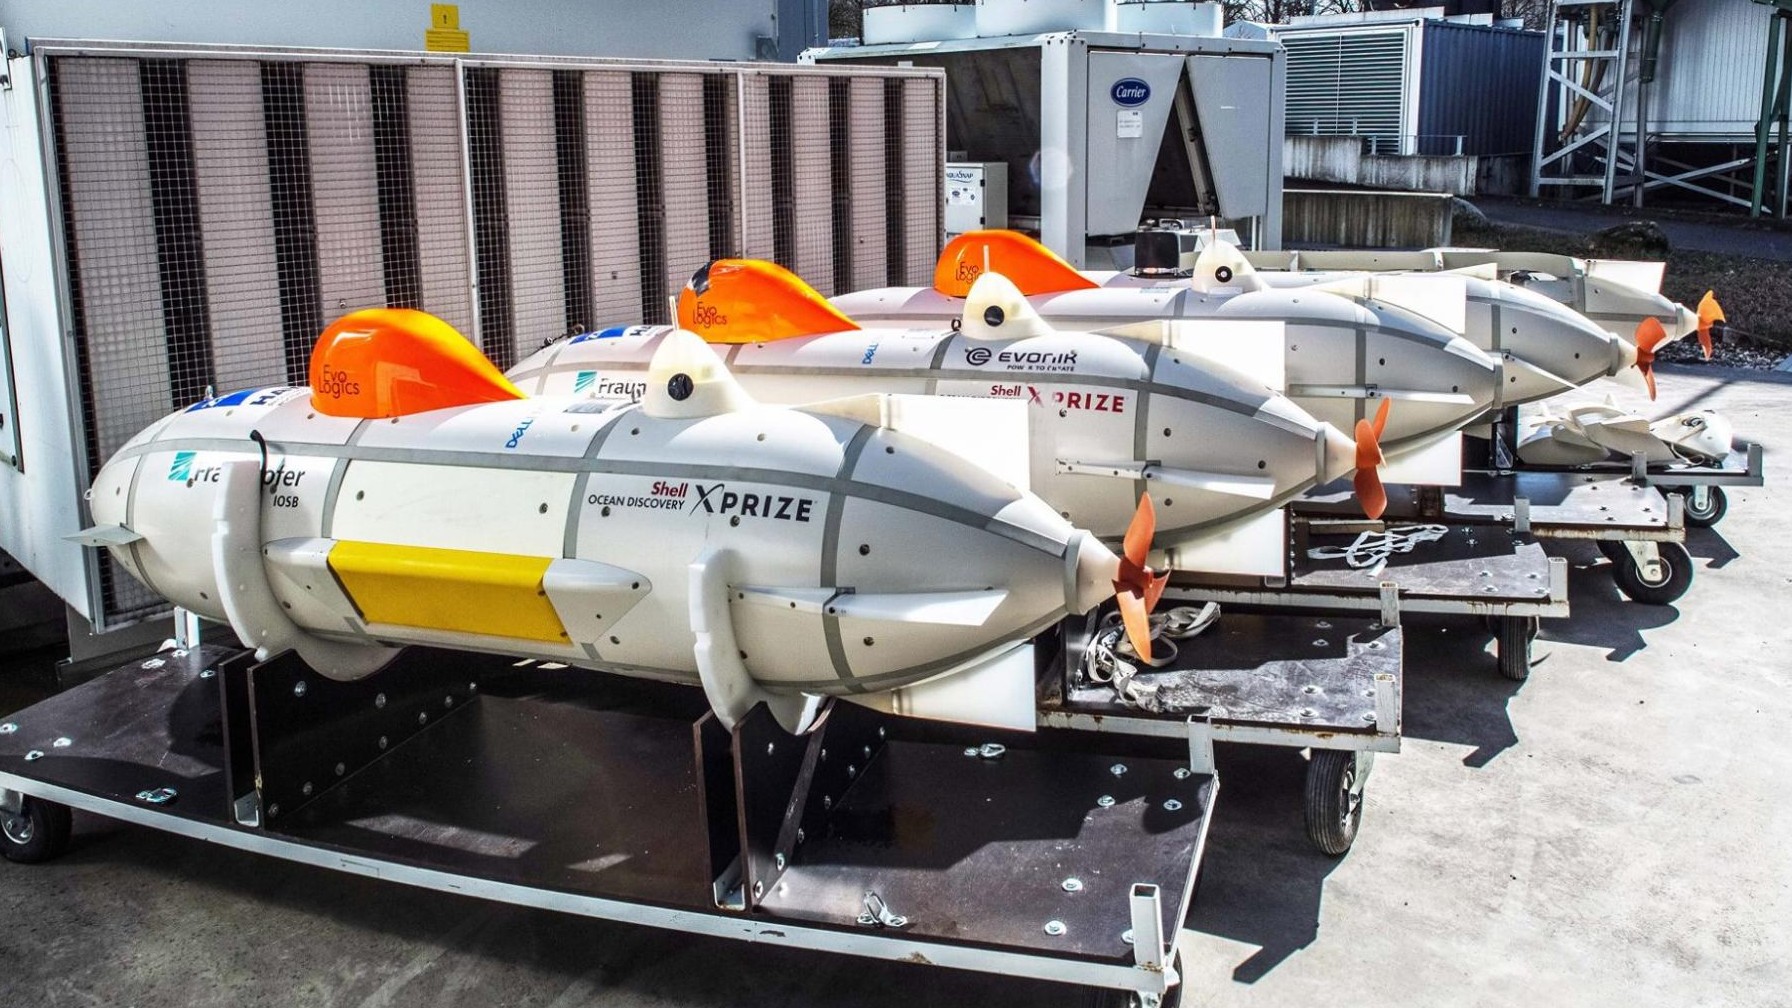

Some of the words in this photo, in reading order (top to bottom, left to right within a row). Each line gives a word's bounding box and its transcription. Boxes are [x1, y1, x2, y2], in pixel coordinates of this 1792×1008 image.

[1116, 85, 1147, 98] Carrier
[959, 261, 979, 273] Evo
[697, 301, 717, 315] Evo
[693, 309, 727, 329] Logics
[323, 364, 347, 383] Evo
[318, 376, 360, 399] Logics
[990, 384, 1021, 397] Shell
[505, 419, 534, 448] DELL
[651, 481, 688, 498] Shell
[273, 495, 299, 508] IOSB
[588, 494, 625, 507] OCEAN
[626, 496, 686, 510] DISCOVERY
[689, 483, 813, 522] XPRIZE
